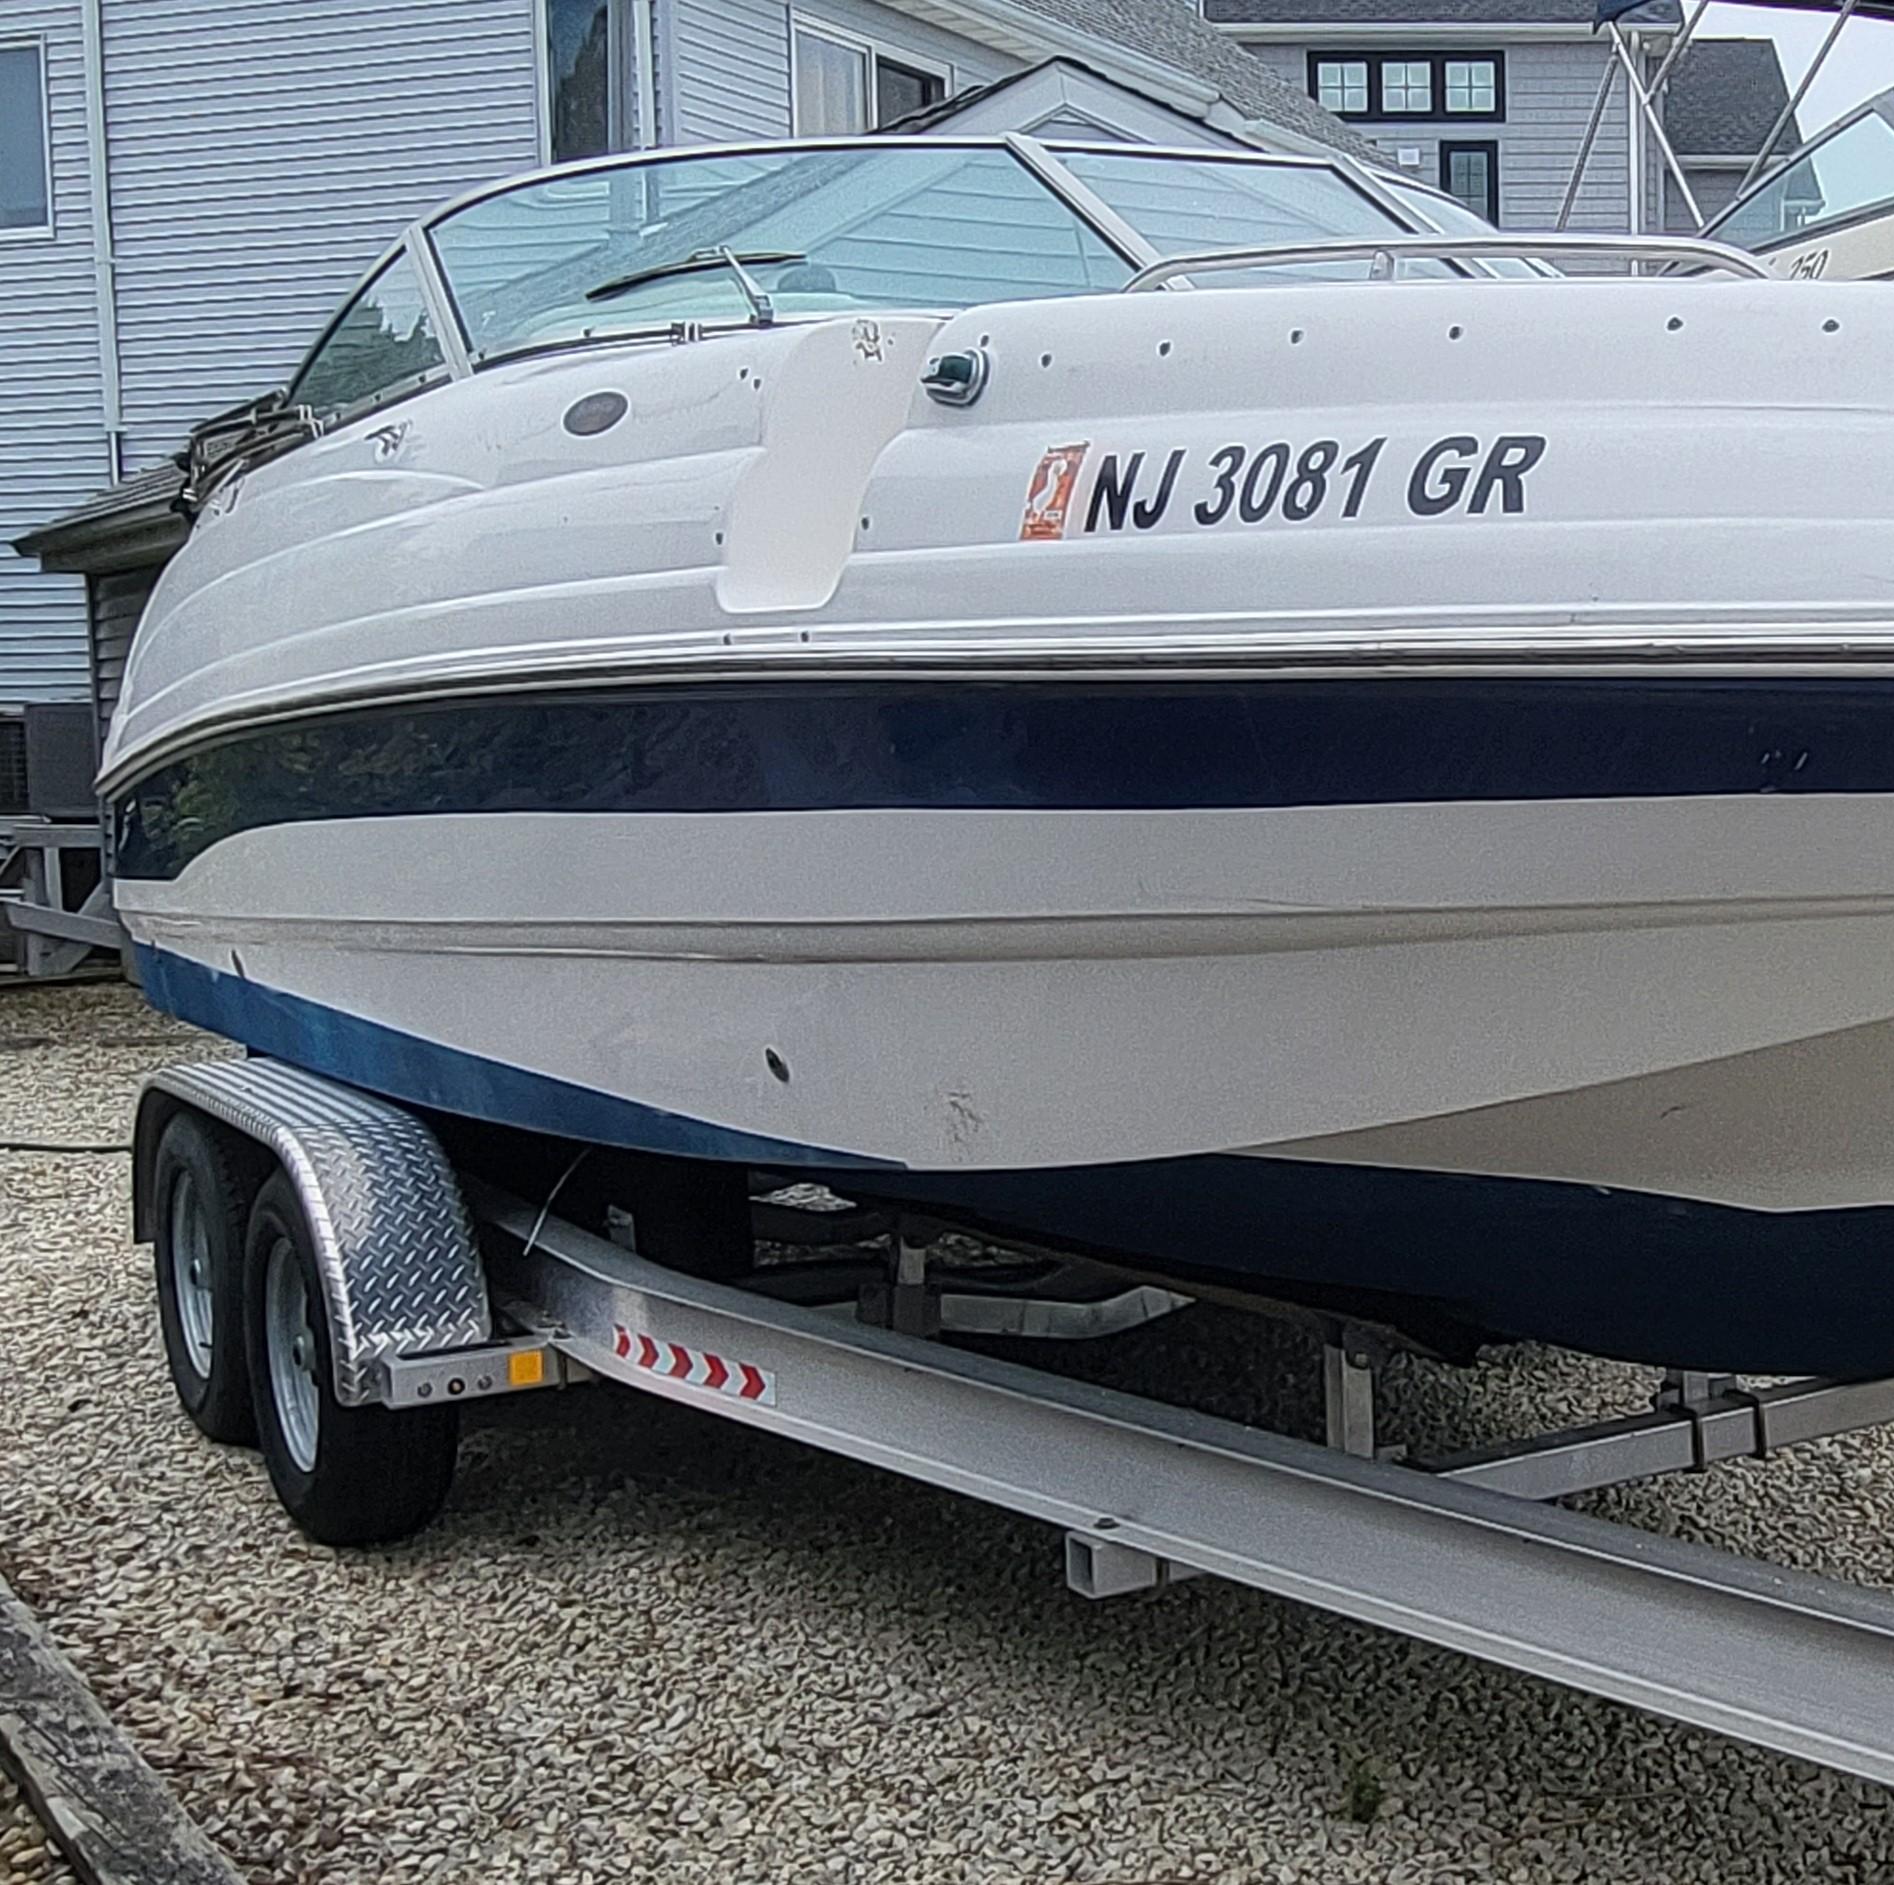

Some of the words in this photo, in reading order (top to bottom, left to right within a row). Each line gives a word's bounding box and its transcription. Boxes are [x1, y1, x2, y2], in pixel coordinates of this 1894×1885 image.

[1085, 449, 1187, 532] NJ
[1194, 437, 1387, 525] 3081
[1407, 435, 1546, 516] GR
